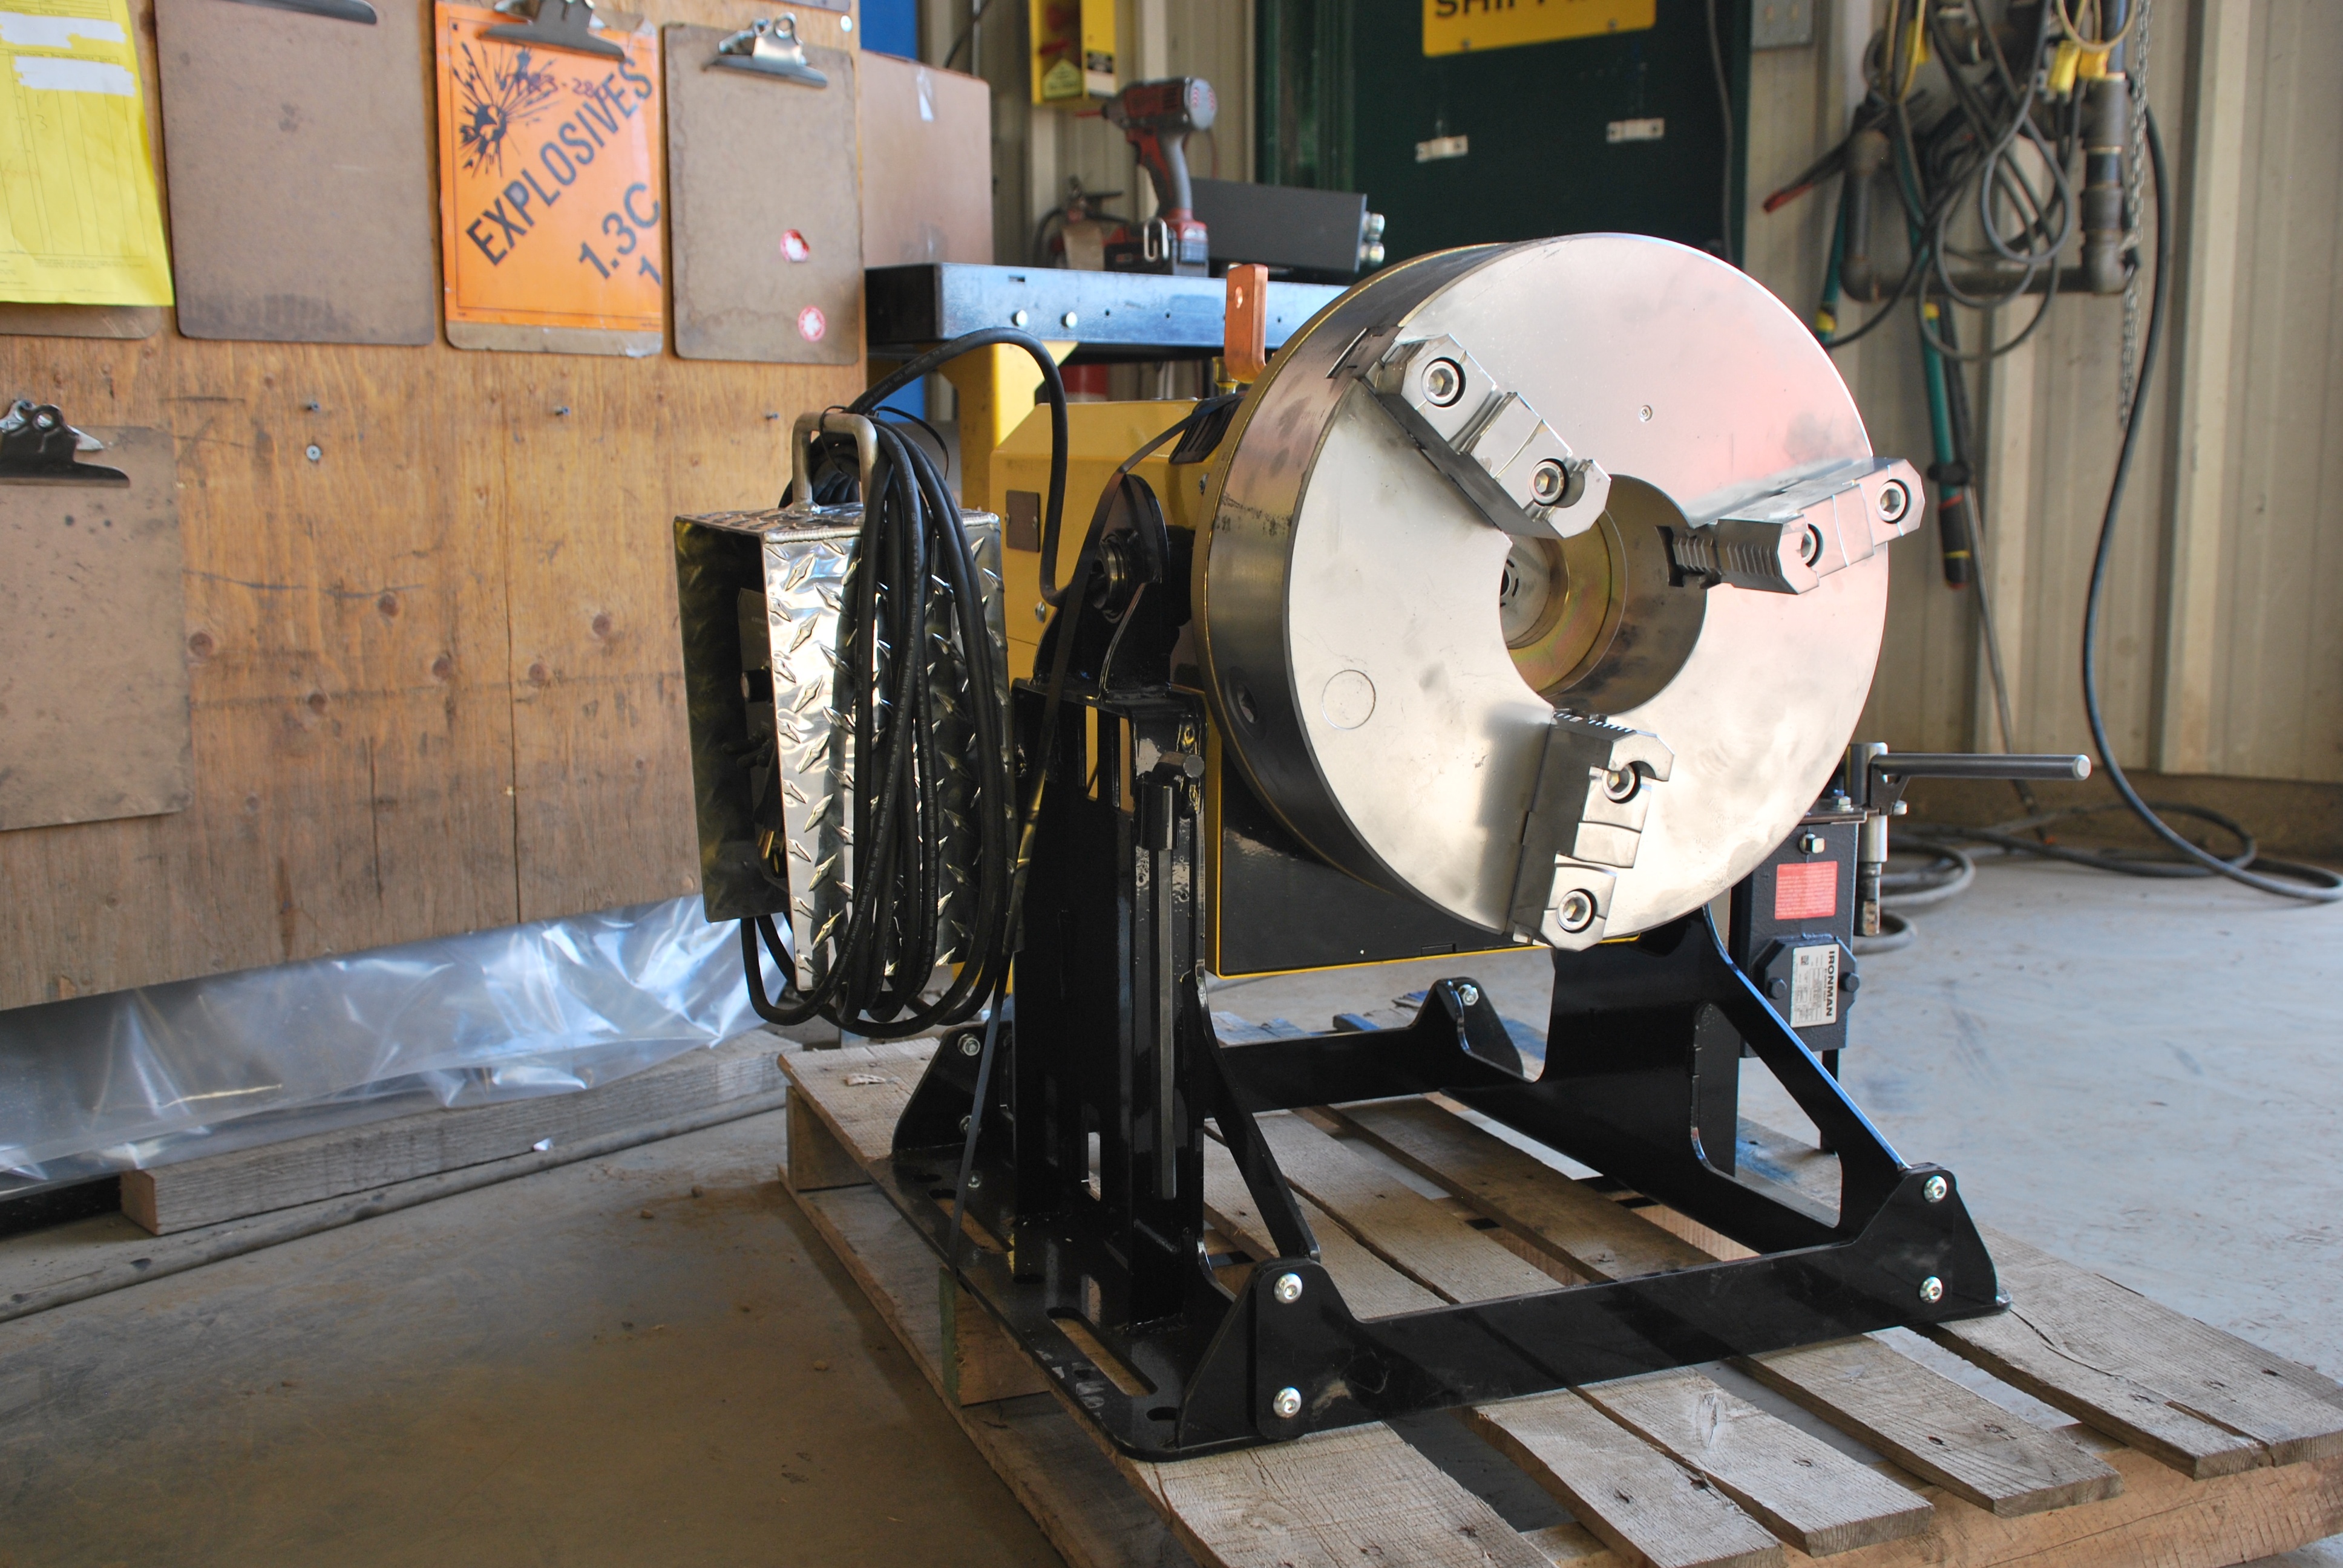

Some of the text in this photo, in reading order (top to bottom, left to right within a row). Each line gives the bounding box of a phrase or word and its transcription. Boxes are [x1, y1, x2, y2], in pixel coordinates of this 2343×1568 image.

[465, 56, 652, 266] EXPLOSIVES
[578, 182, 660, 279] 1.3C
[638, 255, 661, 286] 1
[891, 743, 897, 751] TO
[859, 893, 868, 912] WATER
[849, 913, 863, 940] RESISTANT
[1826, 950, 1835, 1017] IRONMAN
